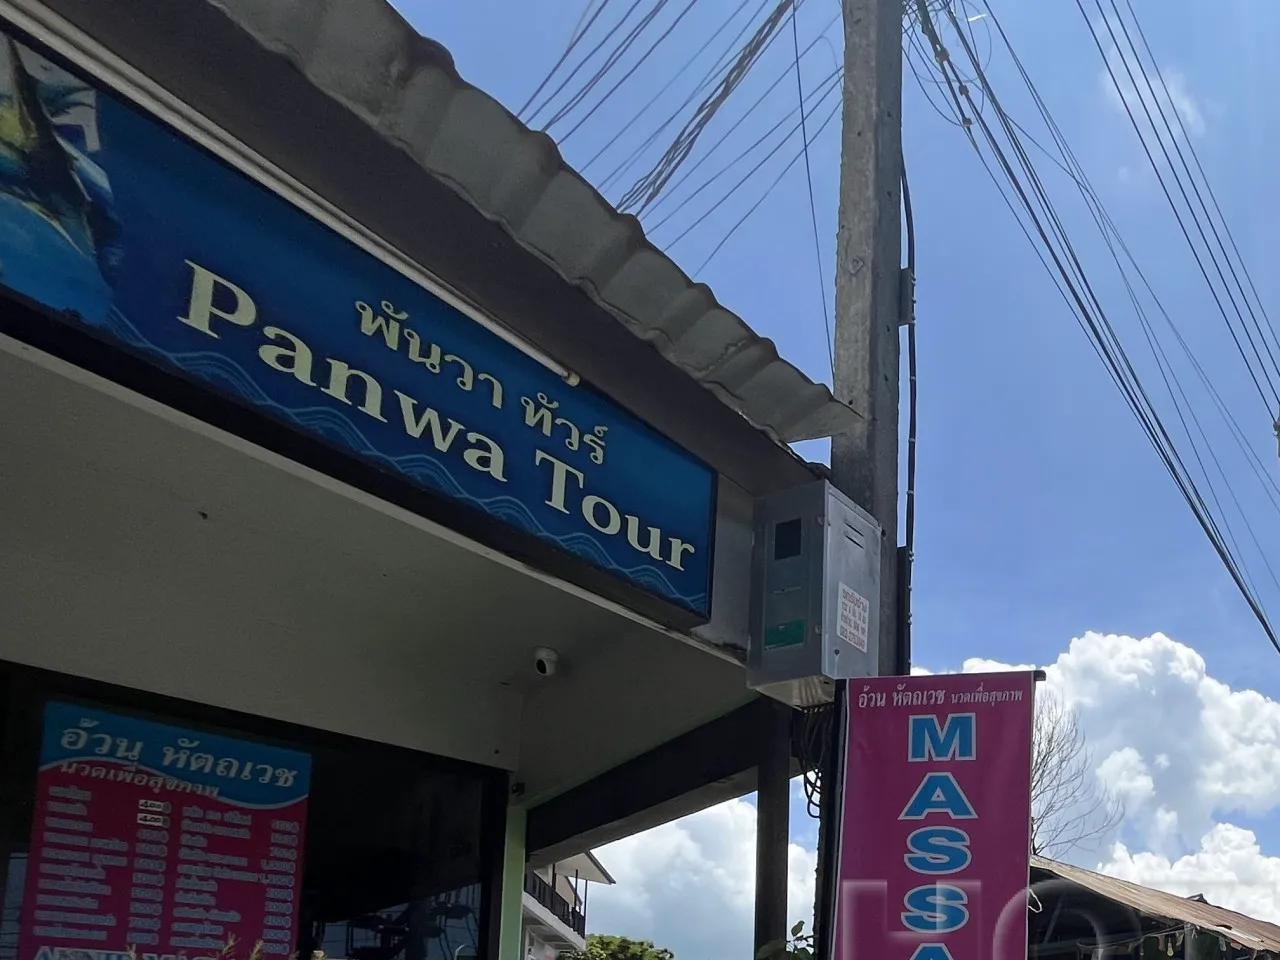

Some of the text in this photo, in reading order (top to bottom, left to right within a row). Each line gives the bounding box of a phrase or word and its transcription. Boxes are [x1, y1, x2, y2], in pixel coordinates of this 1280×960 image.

[177, 258, 695, 572] Panwa Tour
[355, 298, 609, 467] พันวา ทัวร์
[858, 682, 1023, 708] อ้วน หัตถเวช นวดเพื่อสุขภาพ
[59, 762, 220, 799] นวดเพื่อสุขภาพ
[60, 717, 299, 787] อ้วน หัตถเวช
